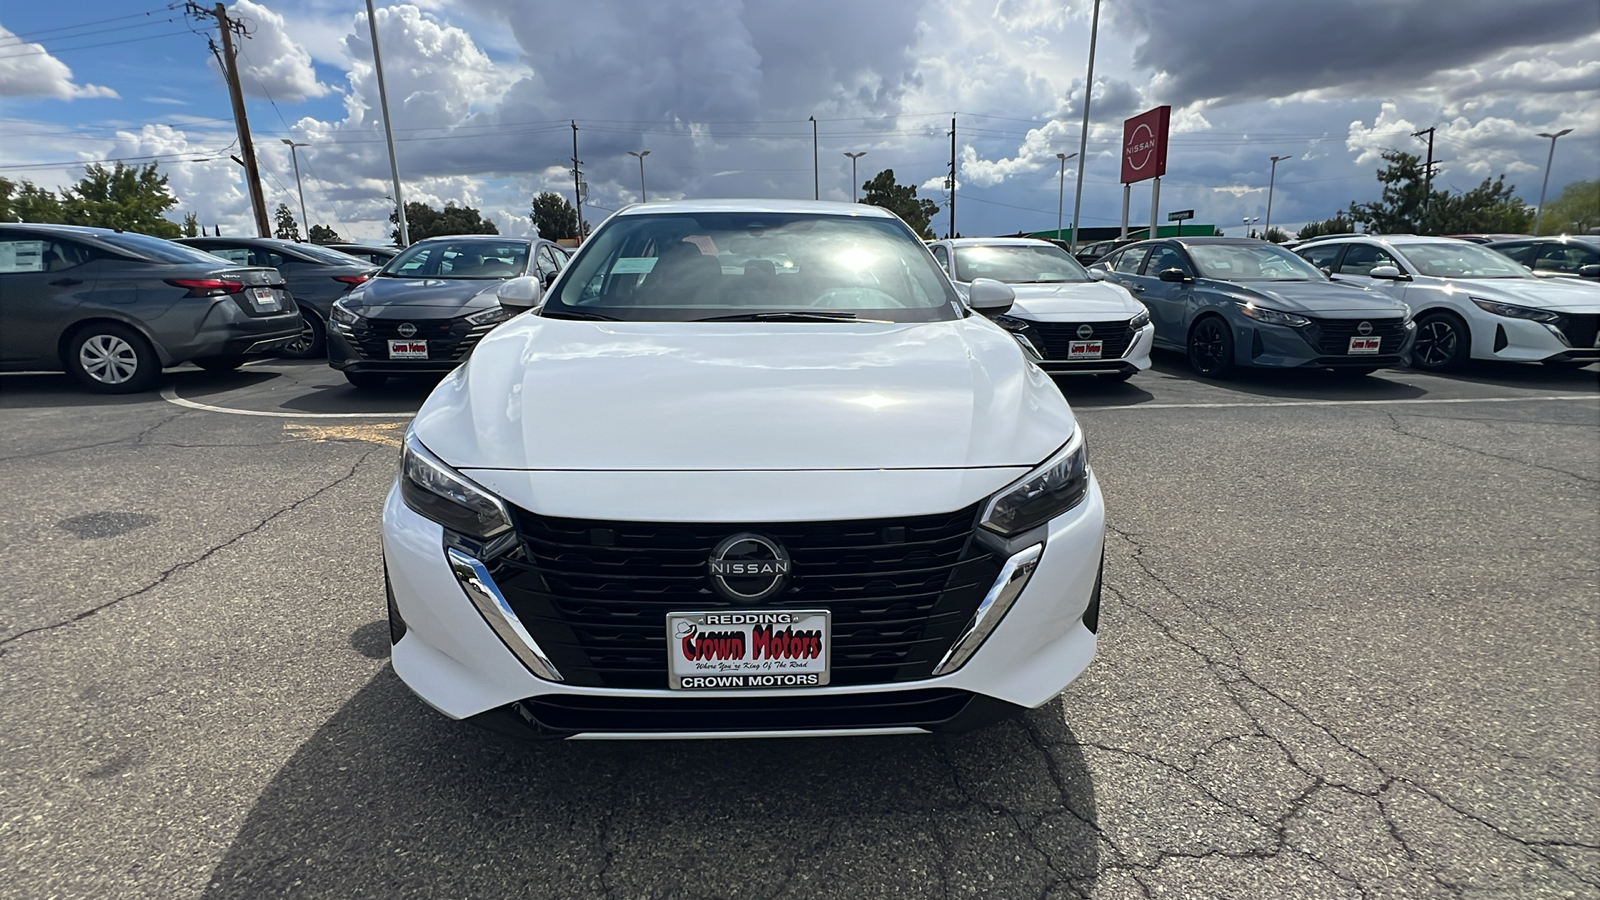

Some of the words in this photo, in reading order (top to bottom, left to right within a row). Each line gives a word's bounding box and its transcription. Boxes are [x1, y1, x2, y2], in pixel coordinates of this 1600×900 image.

[1126, 139, 1155, 155] NISSAN
[711, 562, 788, 574] NISSAN
[707, 614, 791, 625] REDDING
[682, 625, 746, 661] Crown
[752, 624, 822, 661] Motors
[695, 662, 717, 670] Where
[743, 662, 760, 670] King
[762, 661, 772, 670] Of
[774, 660, 787, 668] The
[789, 660, 808, 668] Road
[682, 676, 744, 688] CROWN
[748, 674, 818, 686] MOTORS
